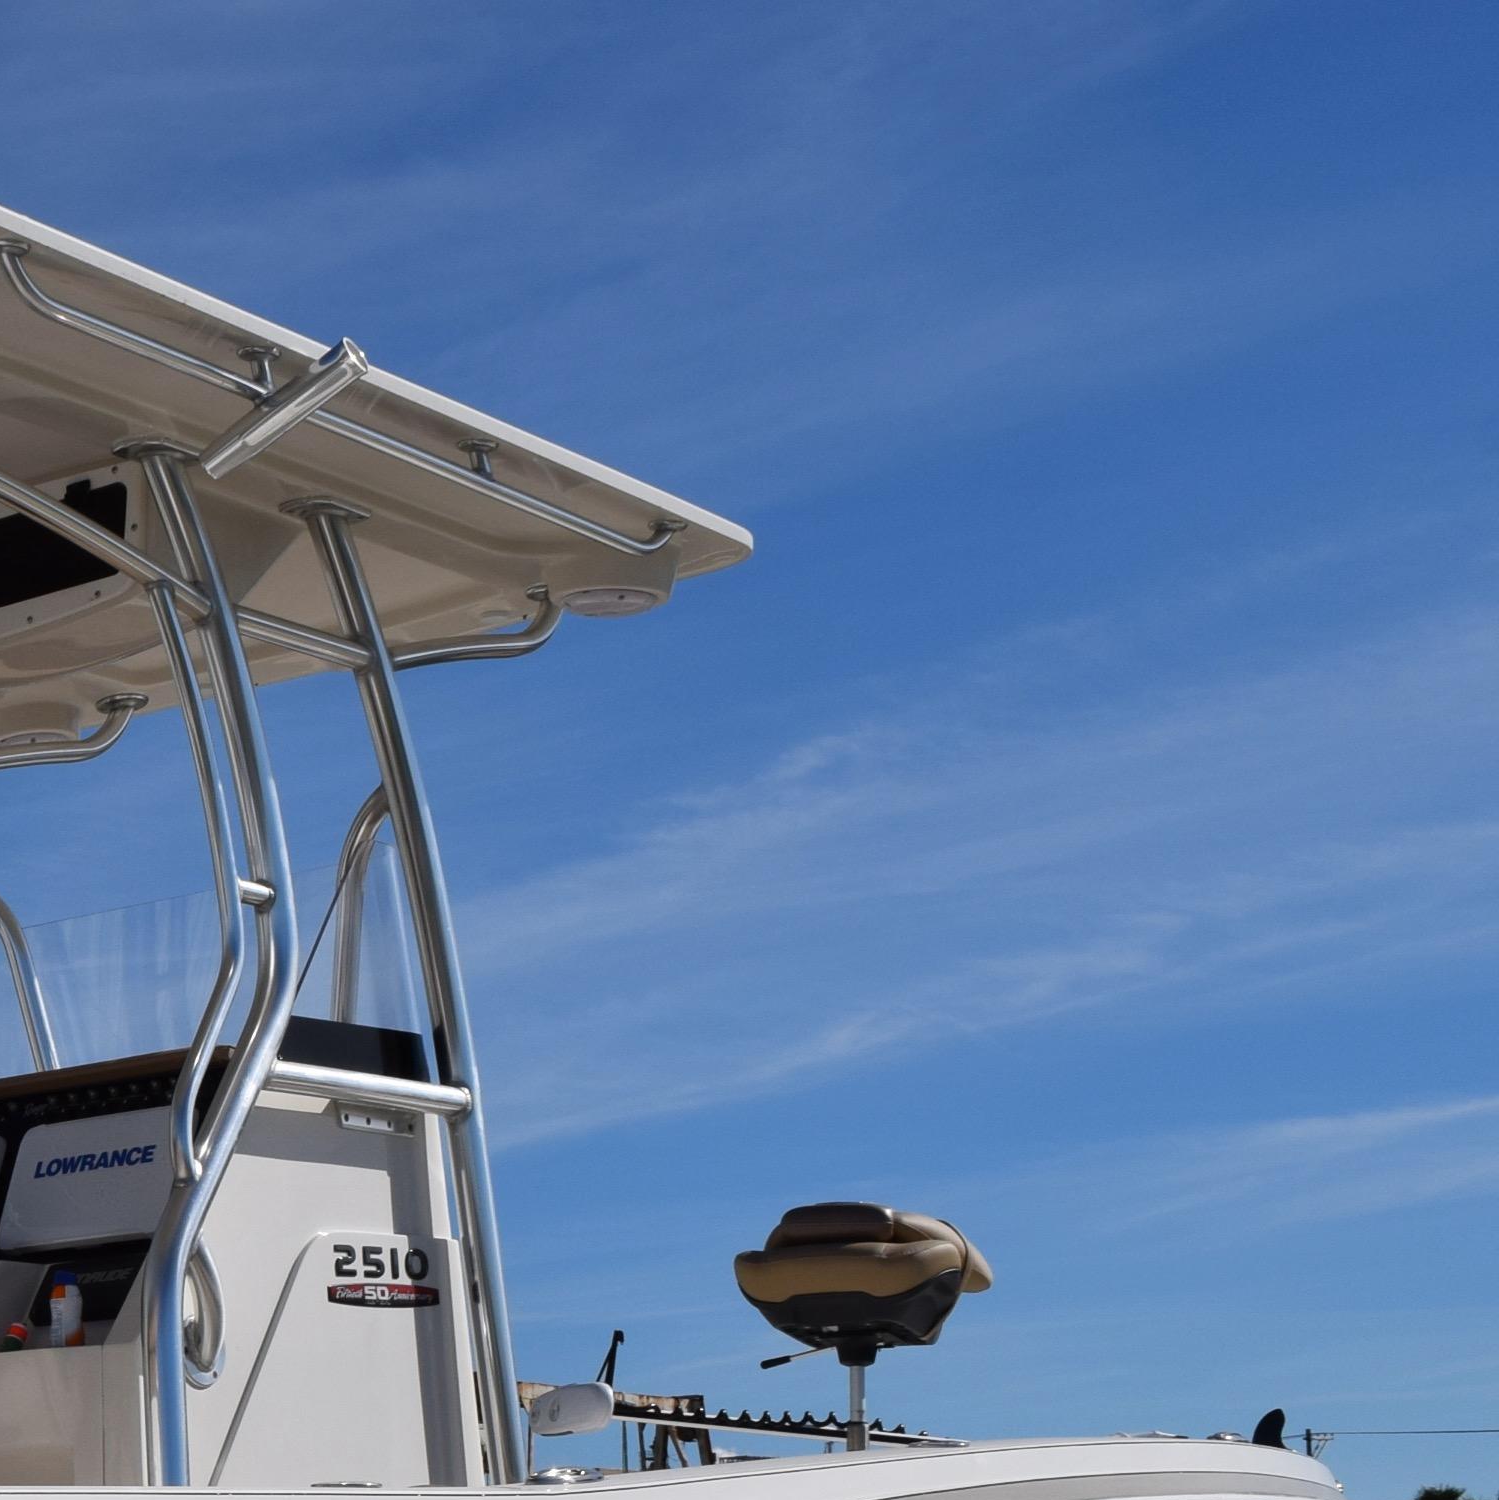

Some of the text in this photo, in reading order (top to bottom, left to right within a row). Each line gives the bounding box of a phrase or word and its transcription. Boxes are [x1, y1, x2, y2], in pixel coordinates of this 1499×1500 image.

[33, 1144, 157, 1178] LOWRANCE
[333, 1244, 429, 1280] 2510
[363, 1285, 389, 1300] 50
